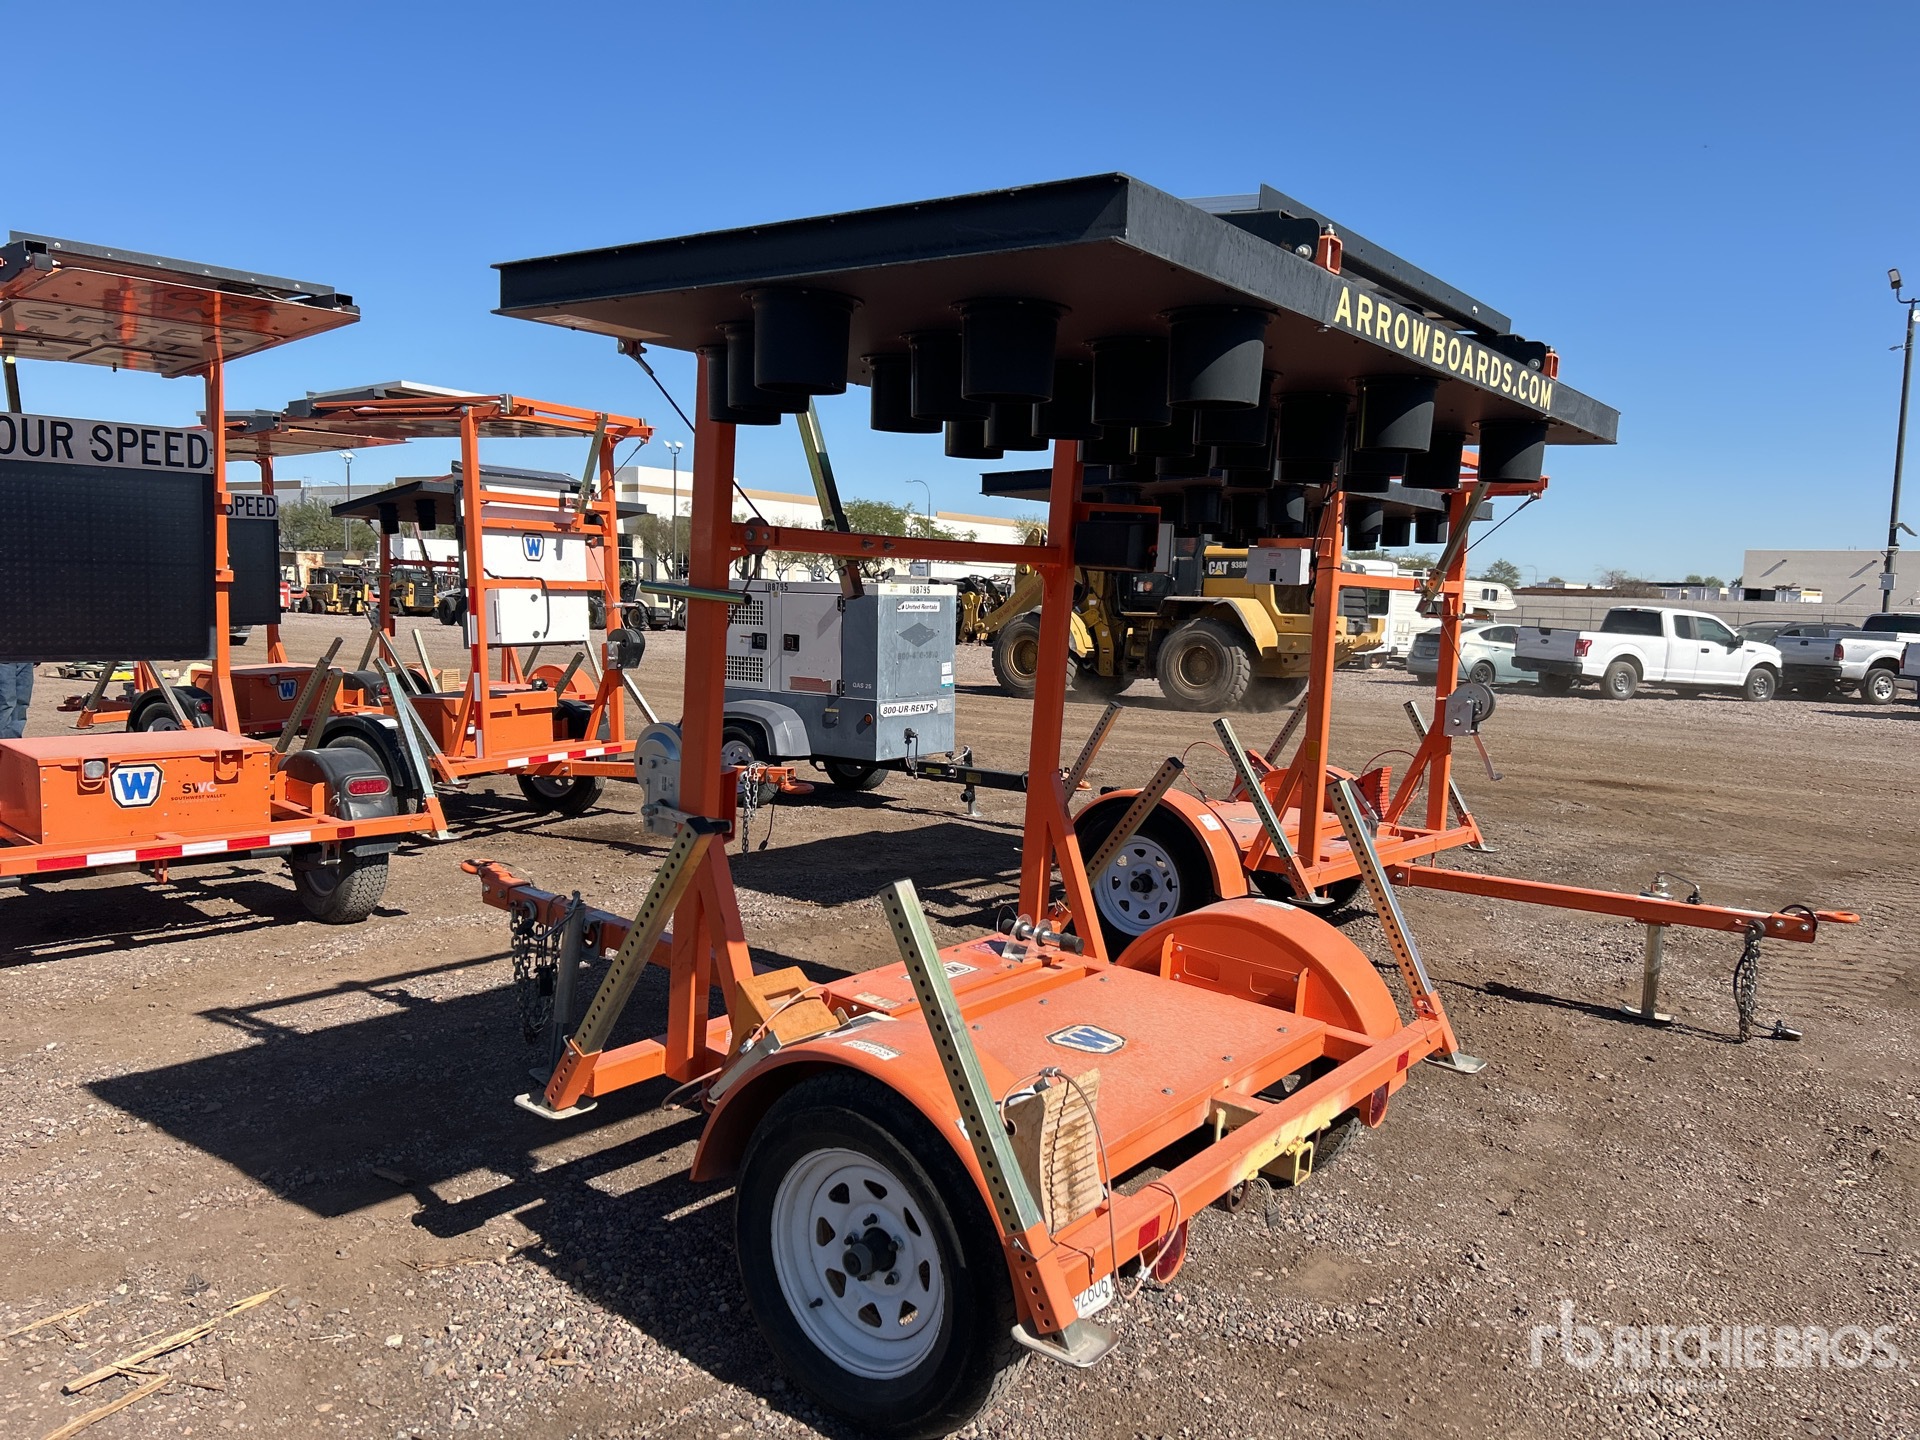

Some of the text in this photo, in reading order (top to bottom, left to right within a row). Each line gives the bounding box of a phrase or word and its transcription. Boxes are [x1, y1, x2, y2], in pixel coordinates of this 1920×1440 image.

[19, 309, 244, 345] SPEED
[1334, 286, 1552, 411] ARROWBOARDS.COM
[91, 425, 208, 469] SPEED
[525, 538, 542, 556] W
[1208, 561, 1229, 575] CAT
[765, 582, 788, 591] 188795
[910, 585, 931, 594] 188795
[280, 682, 295, 697] W
[883, 703, 934, 715] 800-UR-RENTS
[118, 771, 155, 800] W
[182, 781, 217, 794] SWC
[1060, 1027, 1116, 1049] W
